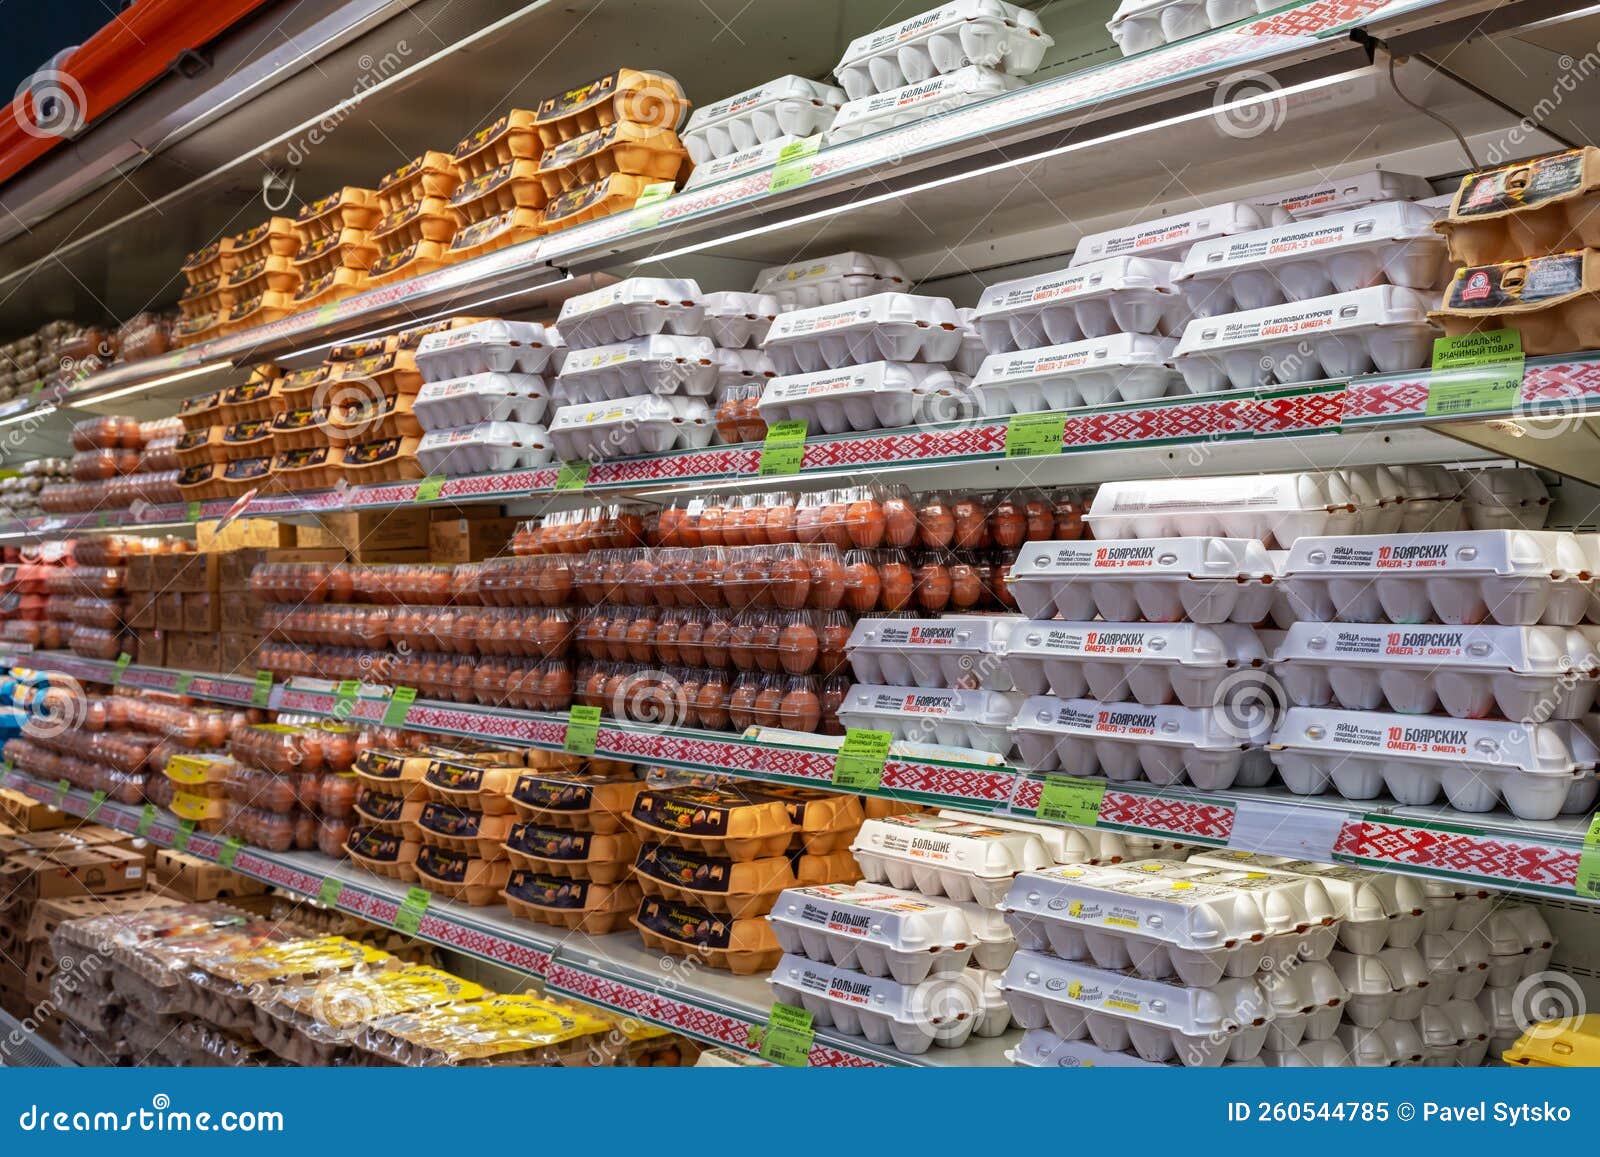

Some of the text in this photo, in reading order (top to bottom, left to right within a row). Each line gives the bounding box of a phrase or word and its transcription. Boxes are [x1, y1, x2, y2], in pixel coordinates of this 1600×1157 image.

[900, 79, 945, 100] БОЛЬШИЕ
[1280, 231, 1314, 243] МОЛОДЫХ
[1315, 225, 1345, 237] КУРОЧЕК
[1305, 308, 1333, 320] КУРОЧЕК
[1451, 335, 1502, 350] СОЦИАЛЬНО
[1438, 343, 1515, 360] ЗНАЧИМЫЙ ТОВАР
[1096, 547, 1155, 560] 10 БОЯРСКИХ
[1378, 544, 1449, 560] 10 БОЯРСКИХ
[1087, 631, 1145, 646] 10 БОЯРСКИХ
[1387, 632, 1463, 648] 10 БОЯРСКИХ
[1098, 711, 1157, 728] 10 БОЯРСКИХ
[1336, 722, 1359, 734] ЯЙЦА
[1388, 726, 1468, 745] 10 БОЯРСКИХ
[911, 837, 951, 854] БОЛЬШИЕ
[830, 910, 871, 929] БОЛЬШИЕ
[830, 976, 873, 997] БОЛЬШИЕ
